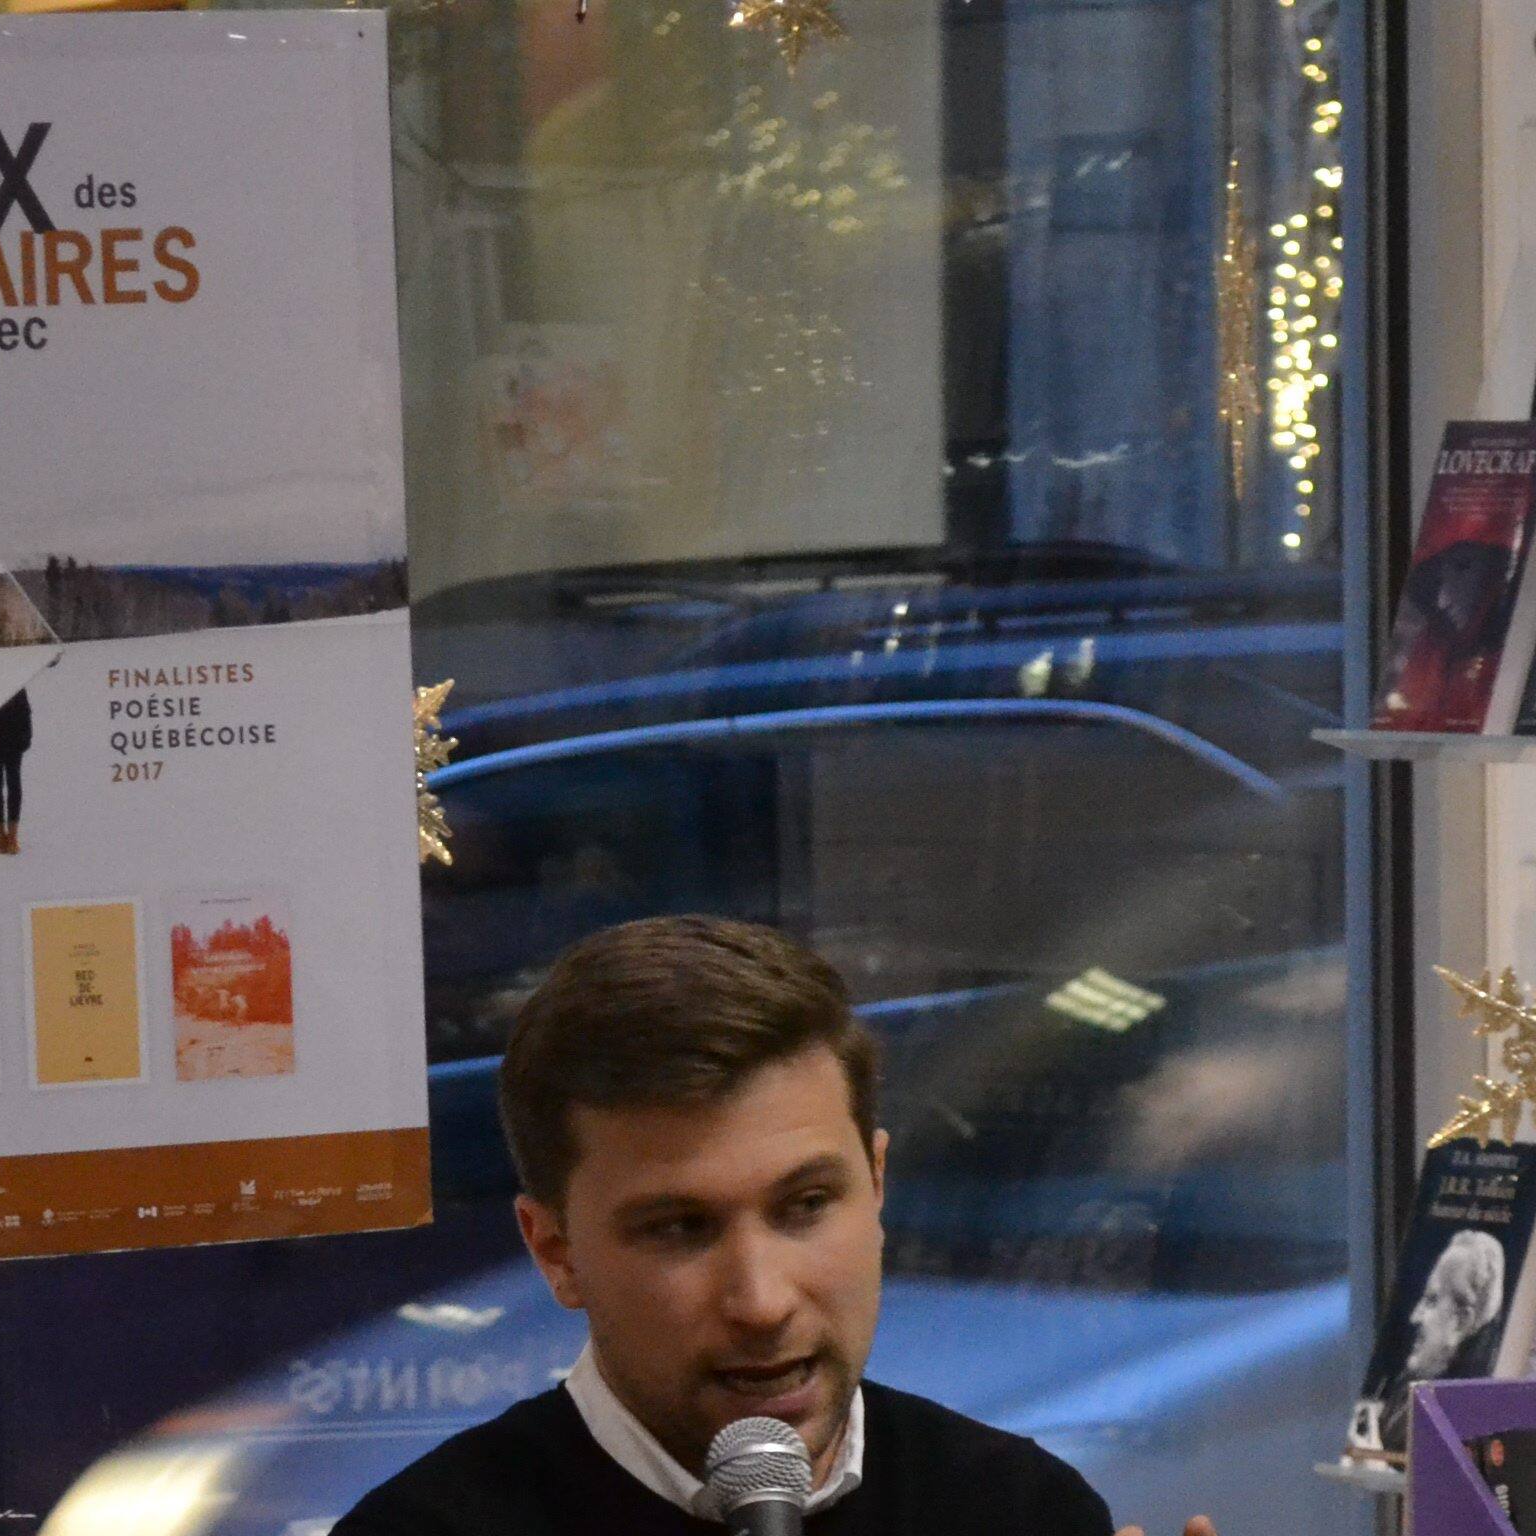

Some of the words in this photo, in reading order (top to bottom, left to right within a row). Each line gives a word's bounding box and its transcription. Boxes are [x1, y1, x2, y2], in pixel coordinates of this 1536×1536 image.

[74, 174, 137, 208] des
[108, 663, 254, 688] FINALISTES
[110, 694, 201, 720] POÉSIE
[111, 723, 276, 755] QUÉBÉCOISE
[111, 761, 164, 782] 2017
